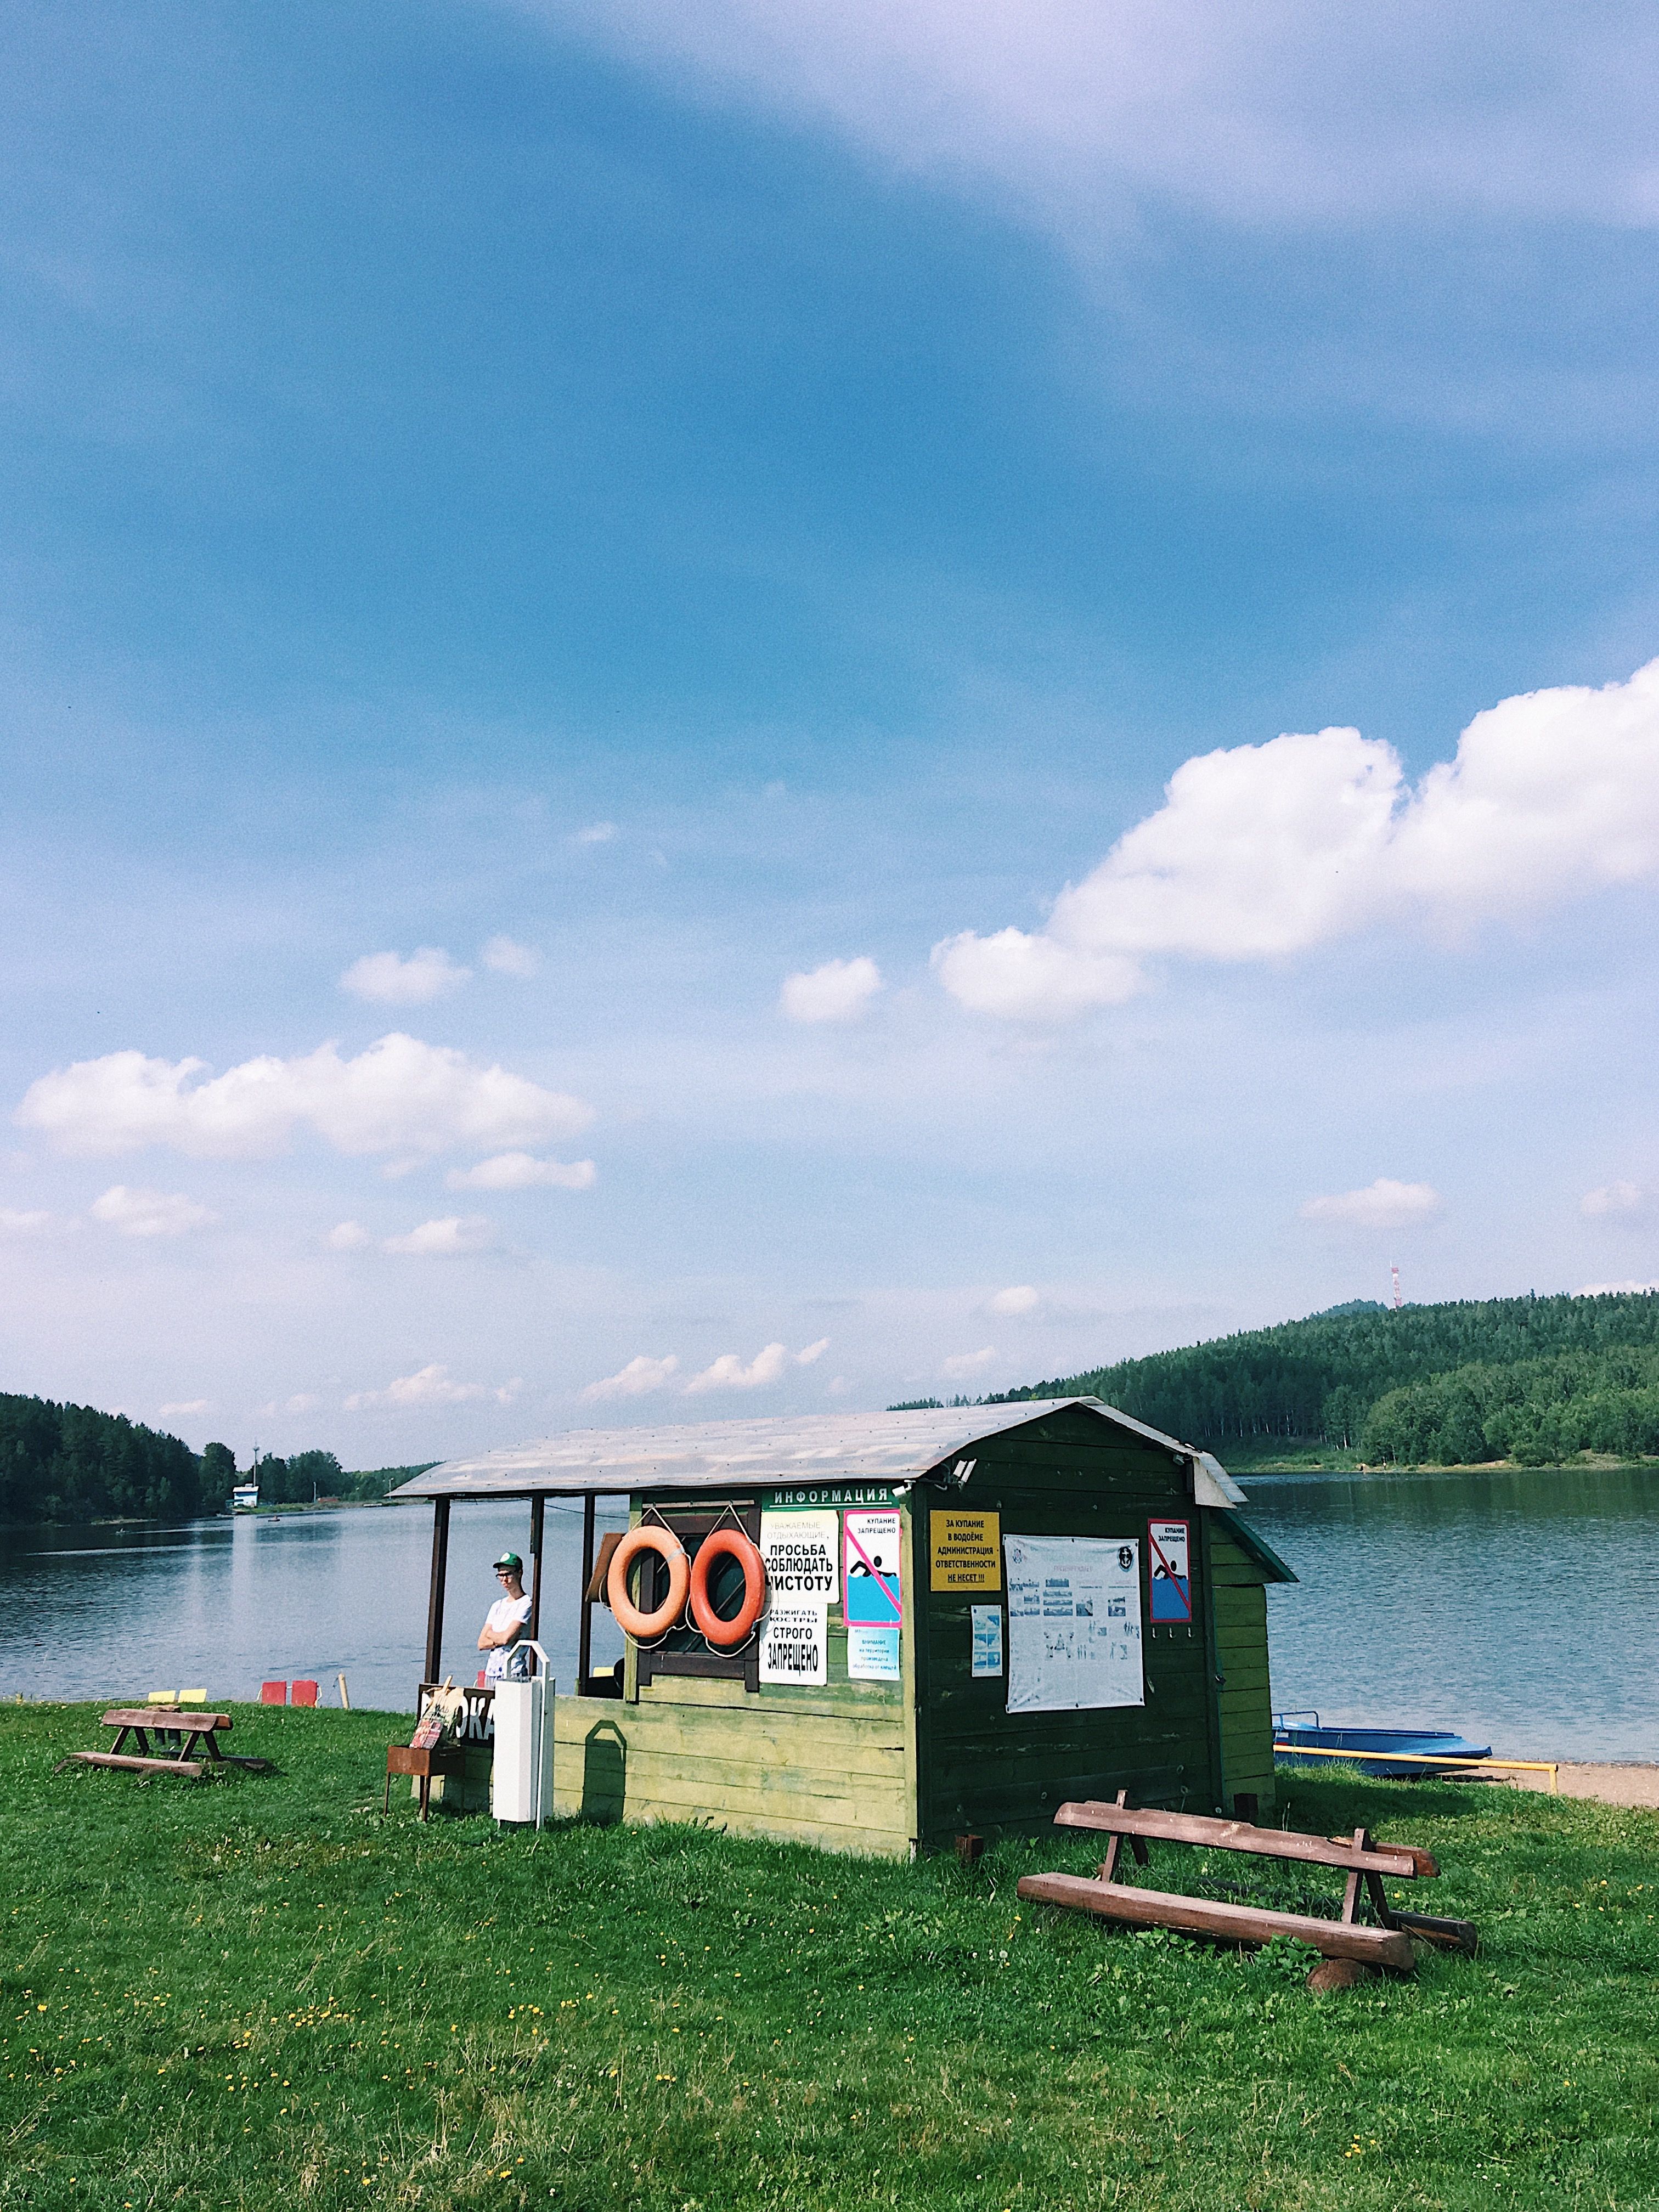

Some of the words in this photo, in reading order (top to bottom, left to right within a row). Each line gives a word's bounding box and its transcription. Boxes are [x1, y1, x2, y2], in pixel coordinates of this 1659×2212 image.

[775, 1488, 887, 1503] ИНФОРМАЦИЯ
[770, 1521, 821, 1530] УВАЖАЕМЫЕ
[946, 1519, 954, 1527] ЗА
[955, 1520, 984, 1528] КУПАНИЕ
[767, 1531, 829, 1540] ОТДЫХАЮЩИЕ,
[953, 1532, 983, 1542] ВОДОЁМЕ
[770, 1544, 826, 1556] ПРОСЬБА
[938, 1547, 993, 1556] АДМИНИСТРАЦИЯ
[765, 1558, 833, 1575] СОБЛЮДАТЬ
[774, 1627, 812, 1640] СТРОГО
[768, 1643, 818, 1677] ЗАПРЕЩЕНО
